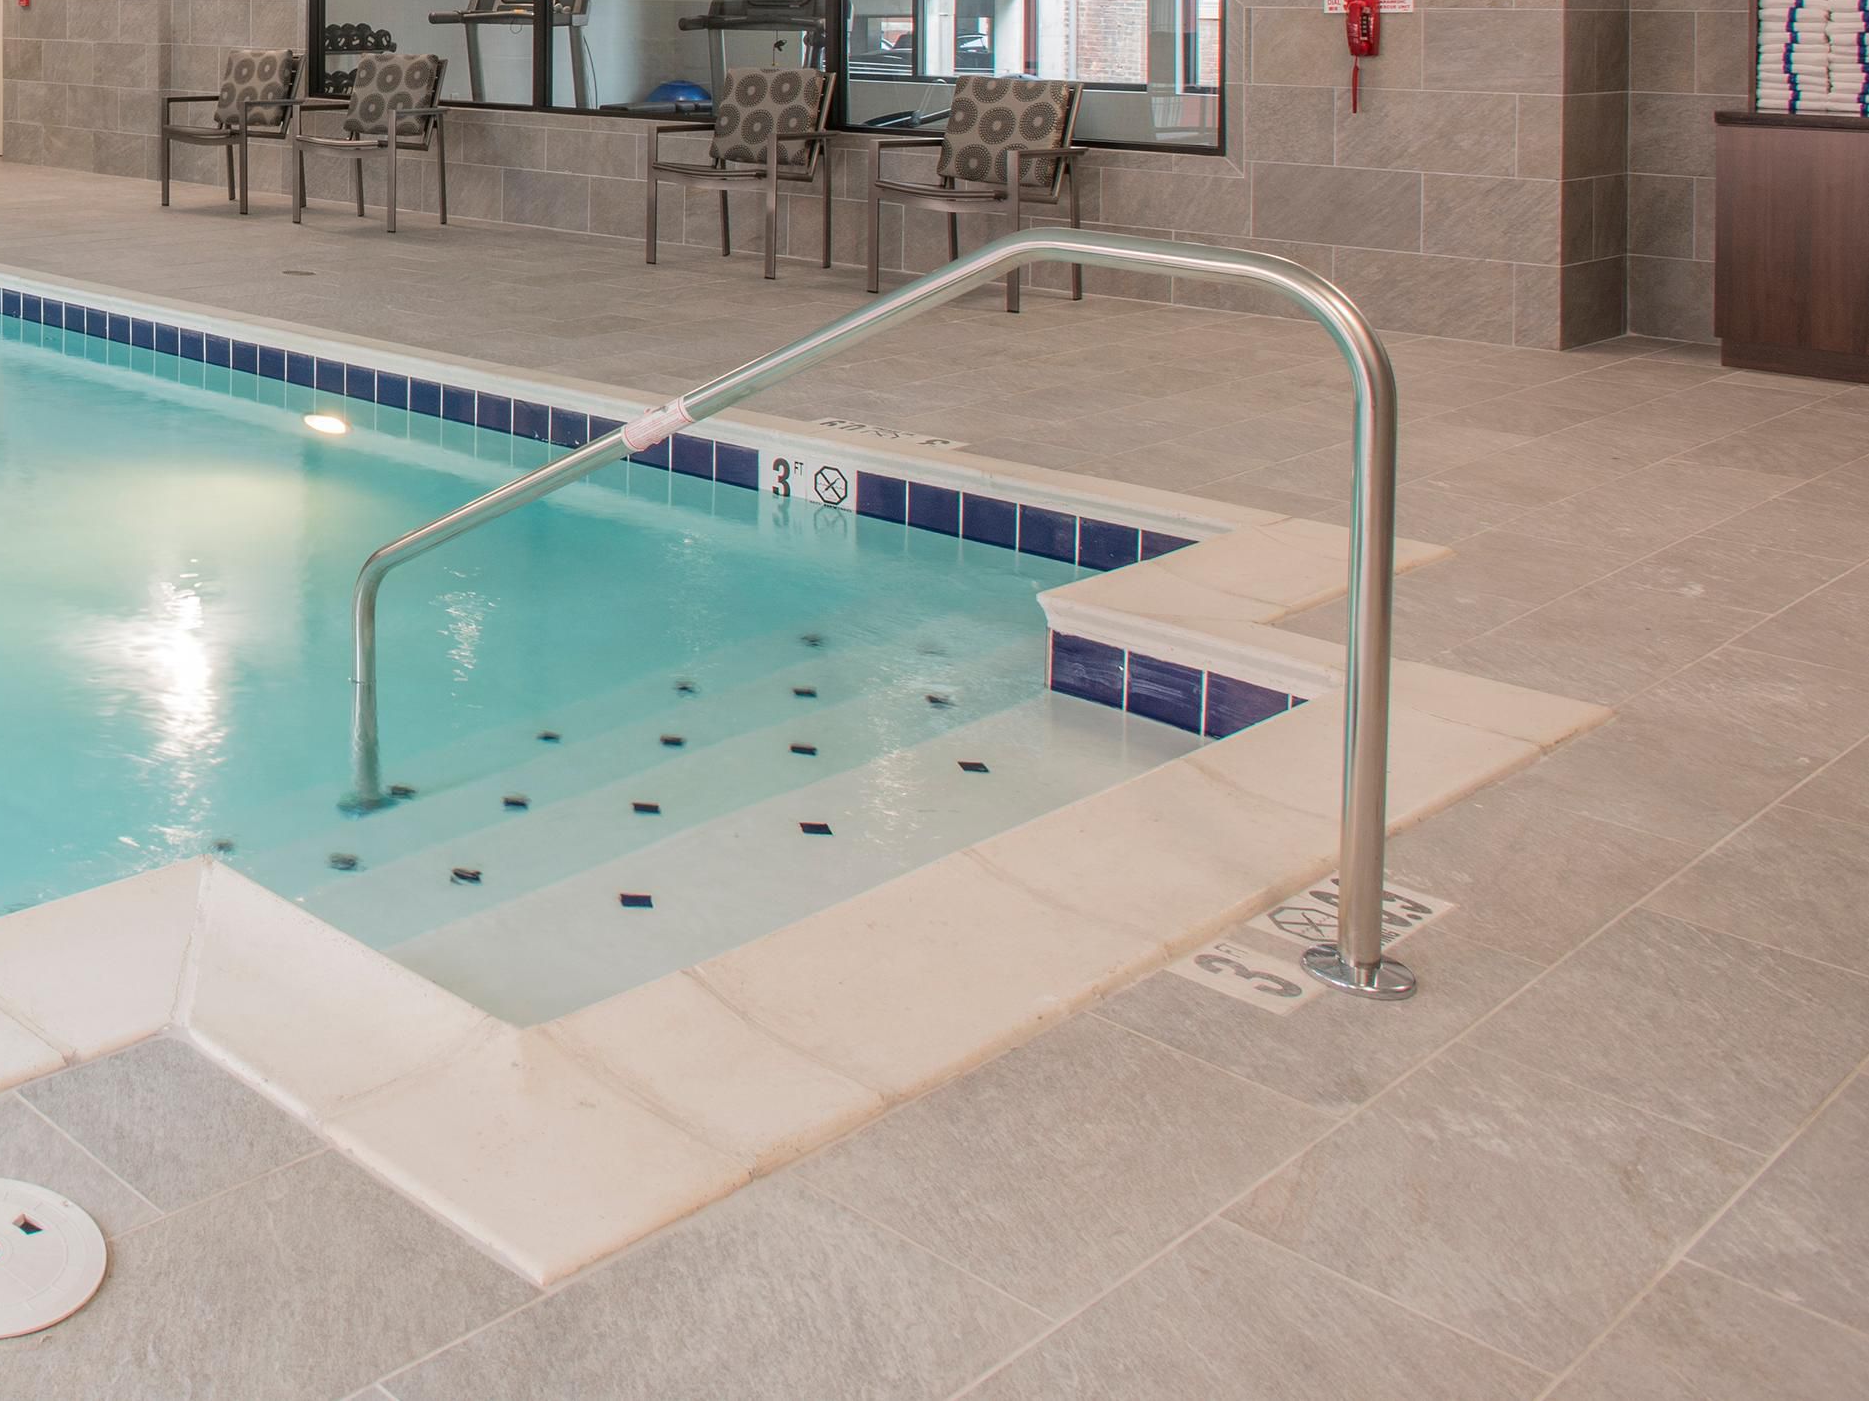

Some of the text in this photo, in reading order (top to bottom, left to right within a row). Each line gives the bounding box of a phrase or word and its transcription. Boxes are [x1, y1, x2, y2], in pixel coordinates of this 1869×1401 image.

[772, 458, 805, 498] 3 FT
[1193, 952, 1303, 999] 3
